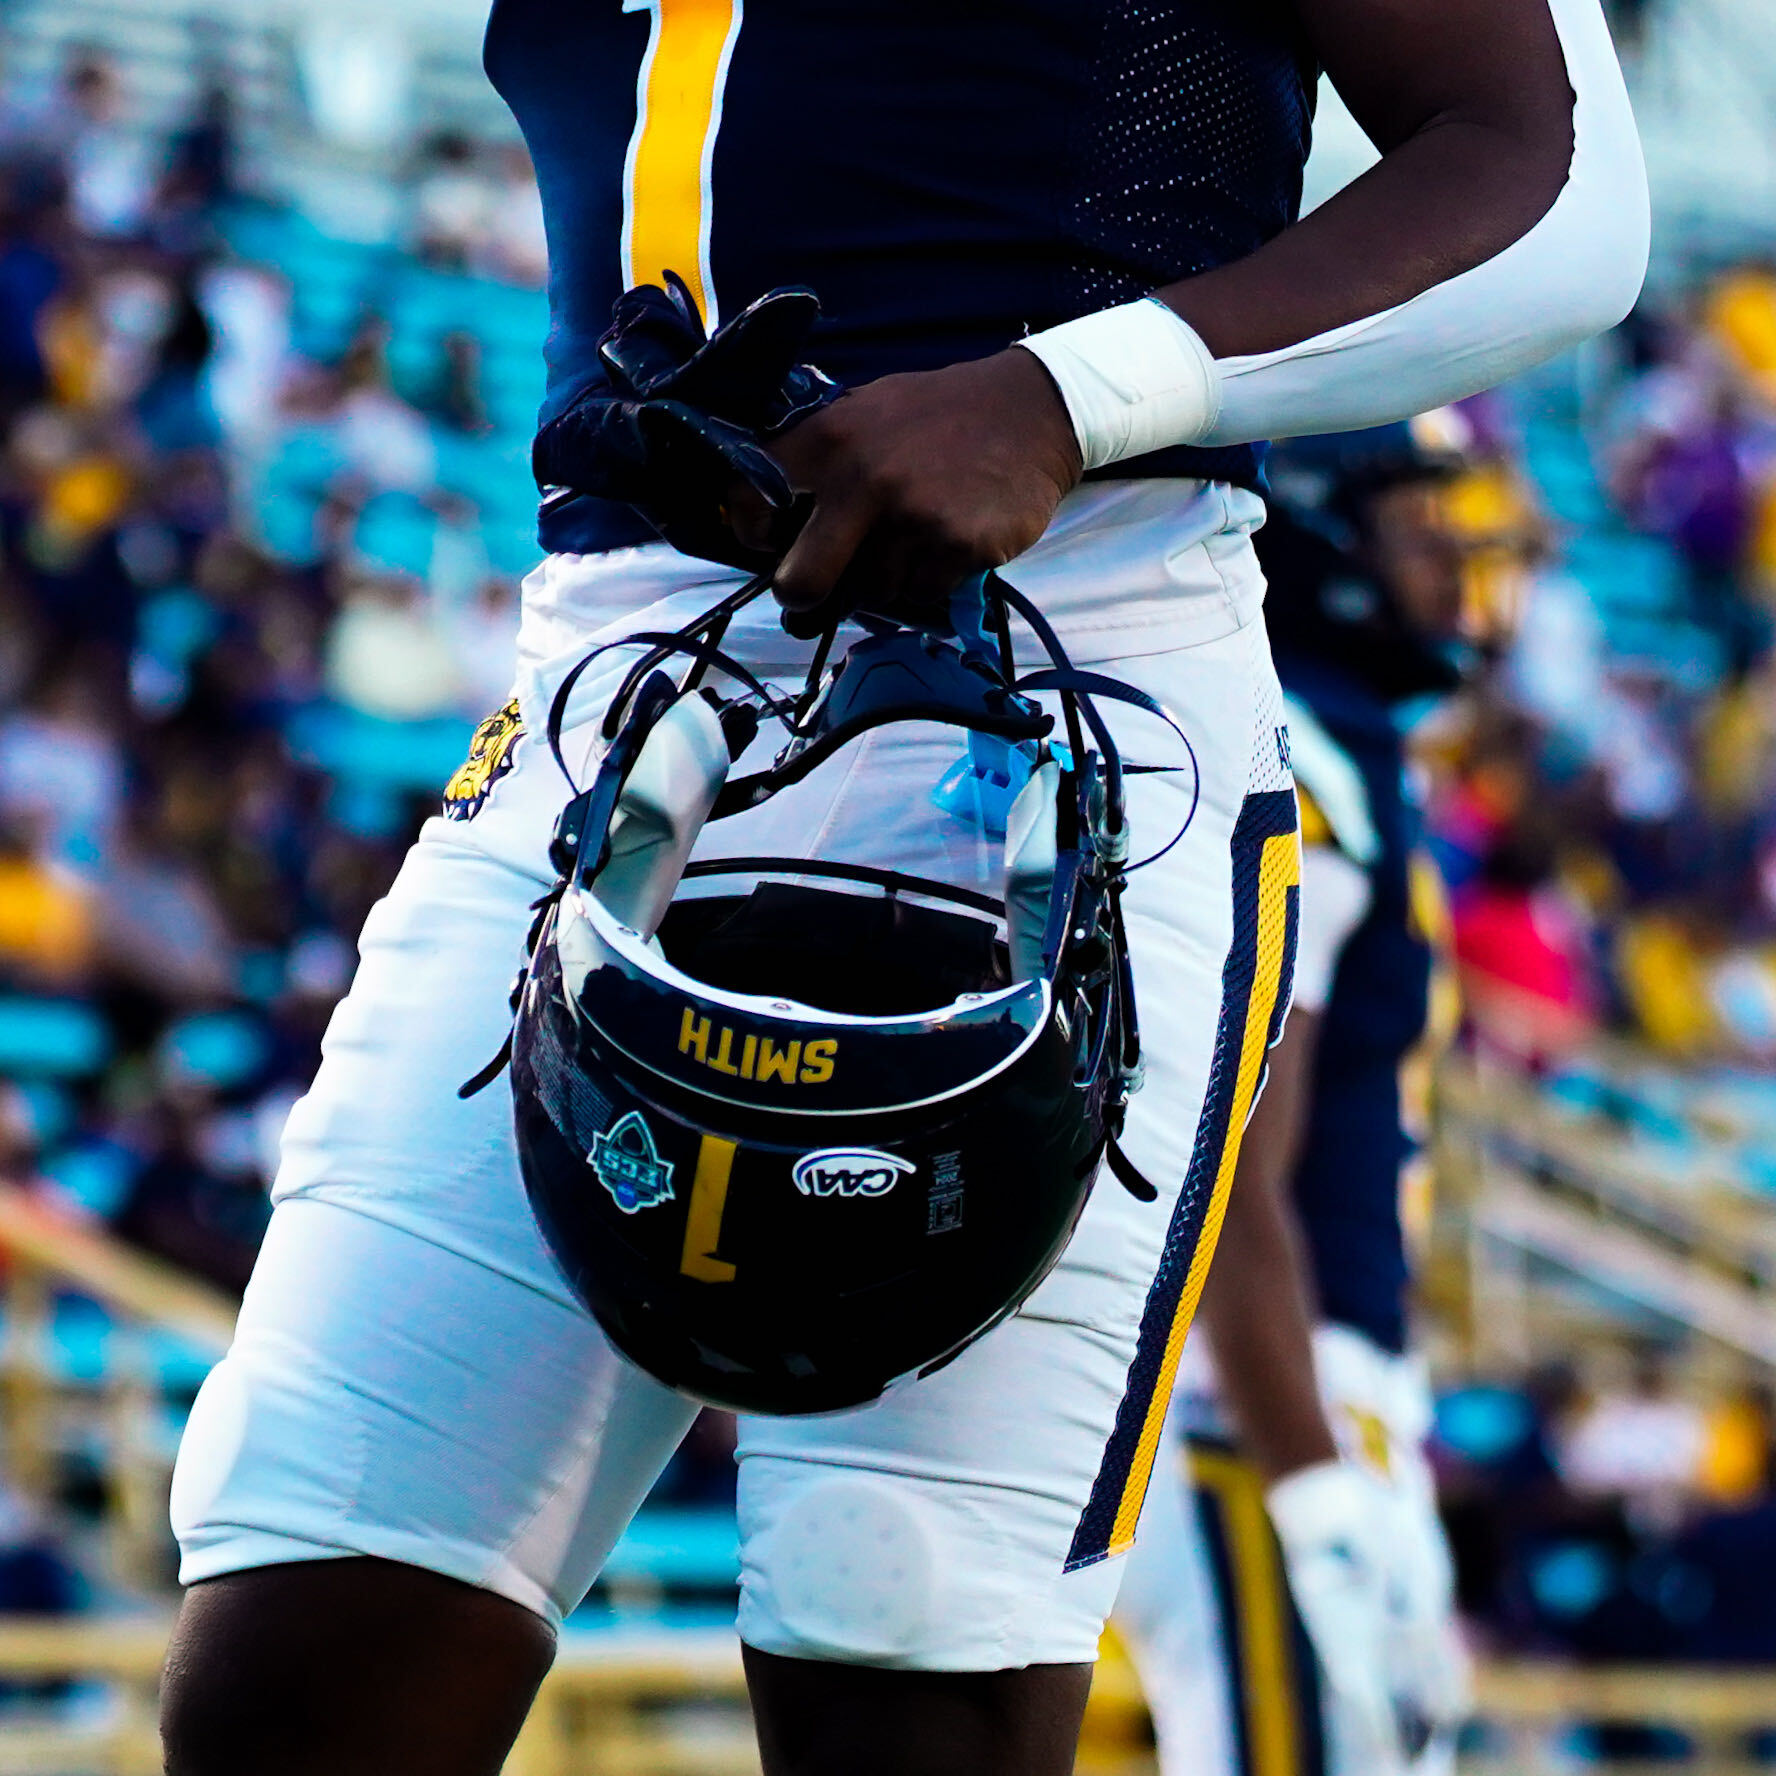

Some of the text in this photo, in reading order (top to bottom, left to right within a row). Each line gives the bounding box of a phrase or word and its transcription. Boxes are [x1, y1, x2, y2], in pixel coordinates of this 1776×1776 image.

[677, 1007, 839, 1084] SMITH
[679, 1133, 739, 1283] 1
[813, 1167, 896, 1196] CAA
